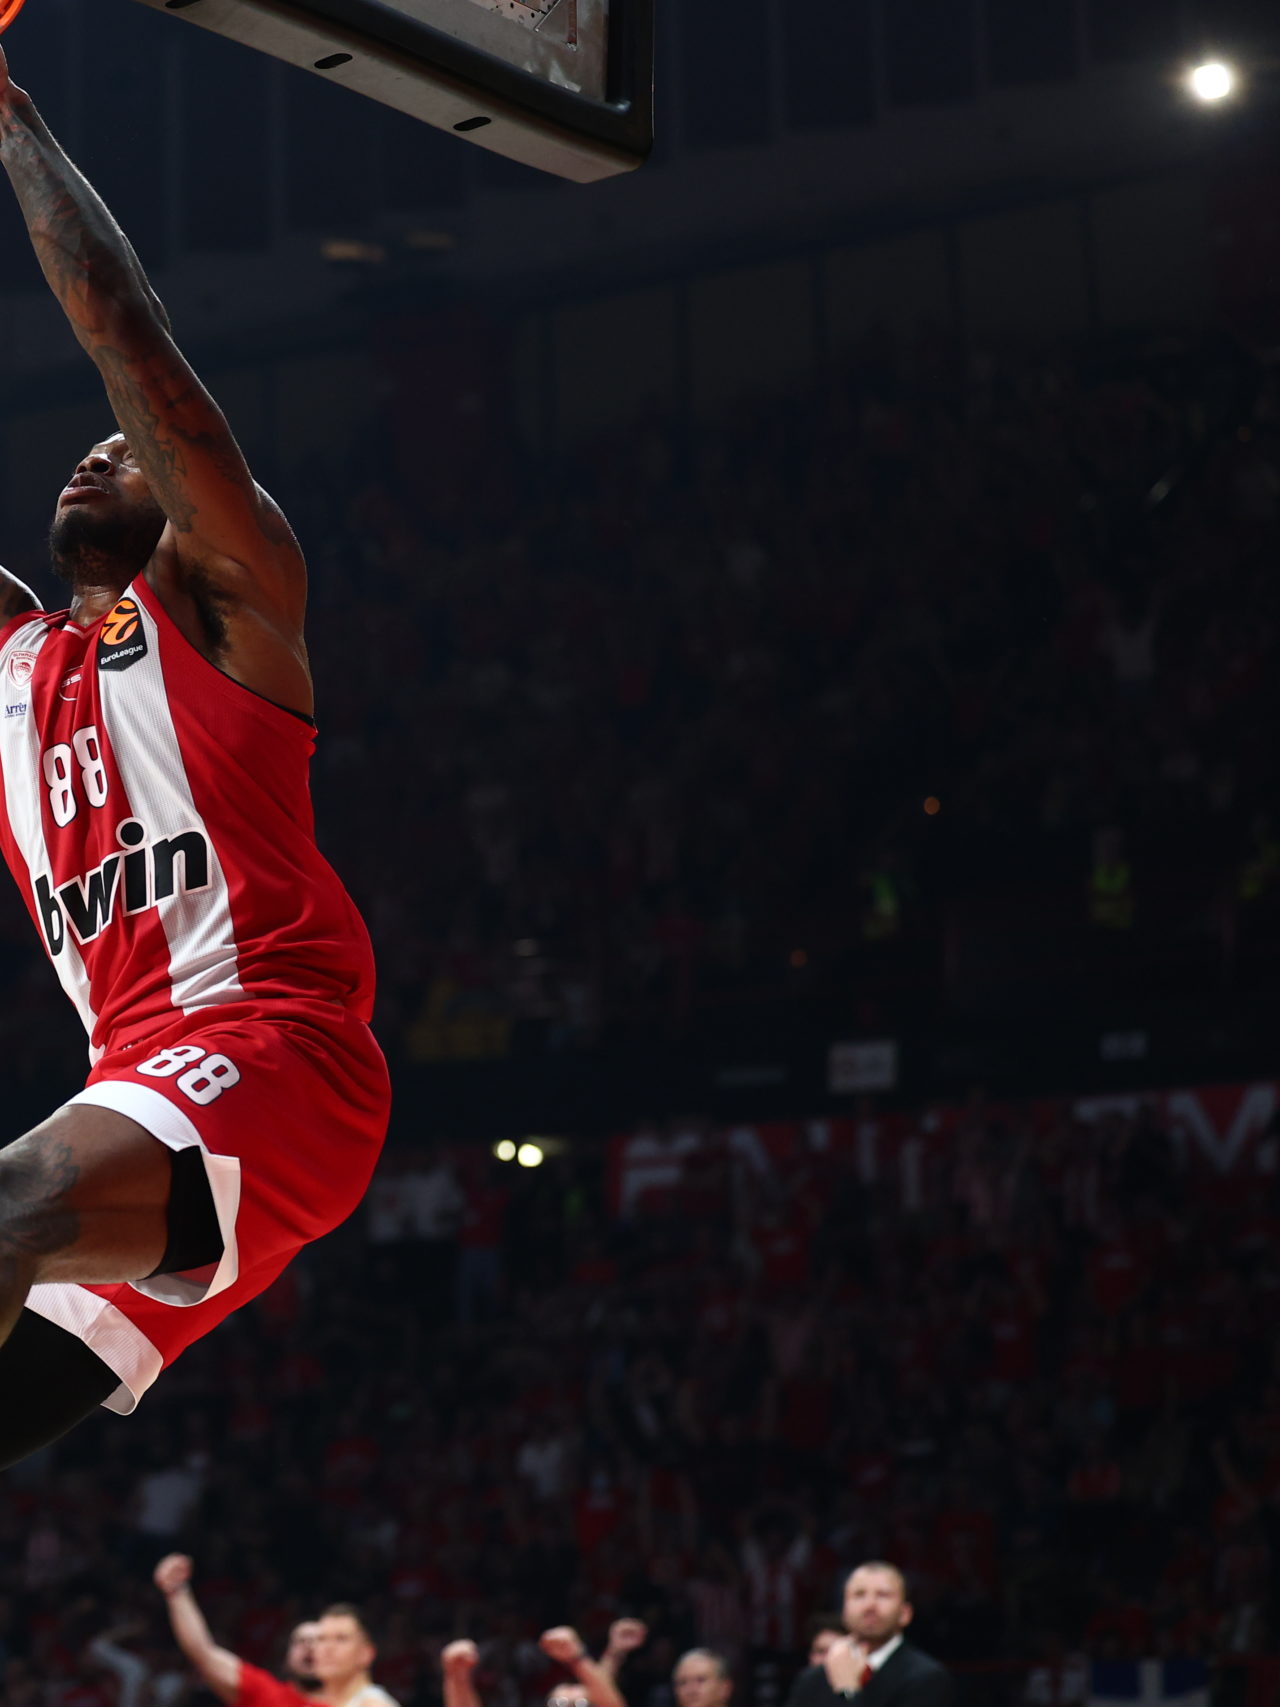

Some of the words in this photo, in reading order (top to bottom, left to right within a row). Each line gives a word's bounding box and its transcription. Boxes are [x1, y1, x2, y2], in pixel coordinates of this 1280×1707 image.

[100, 644, 143, 665] EuroLeague
[43, 725, 108, 828] 88
[33, 819, 210, 957] bwin
[136, 1045, 240, 1106] 88
